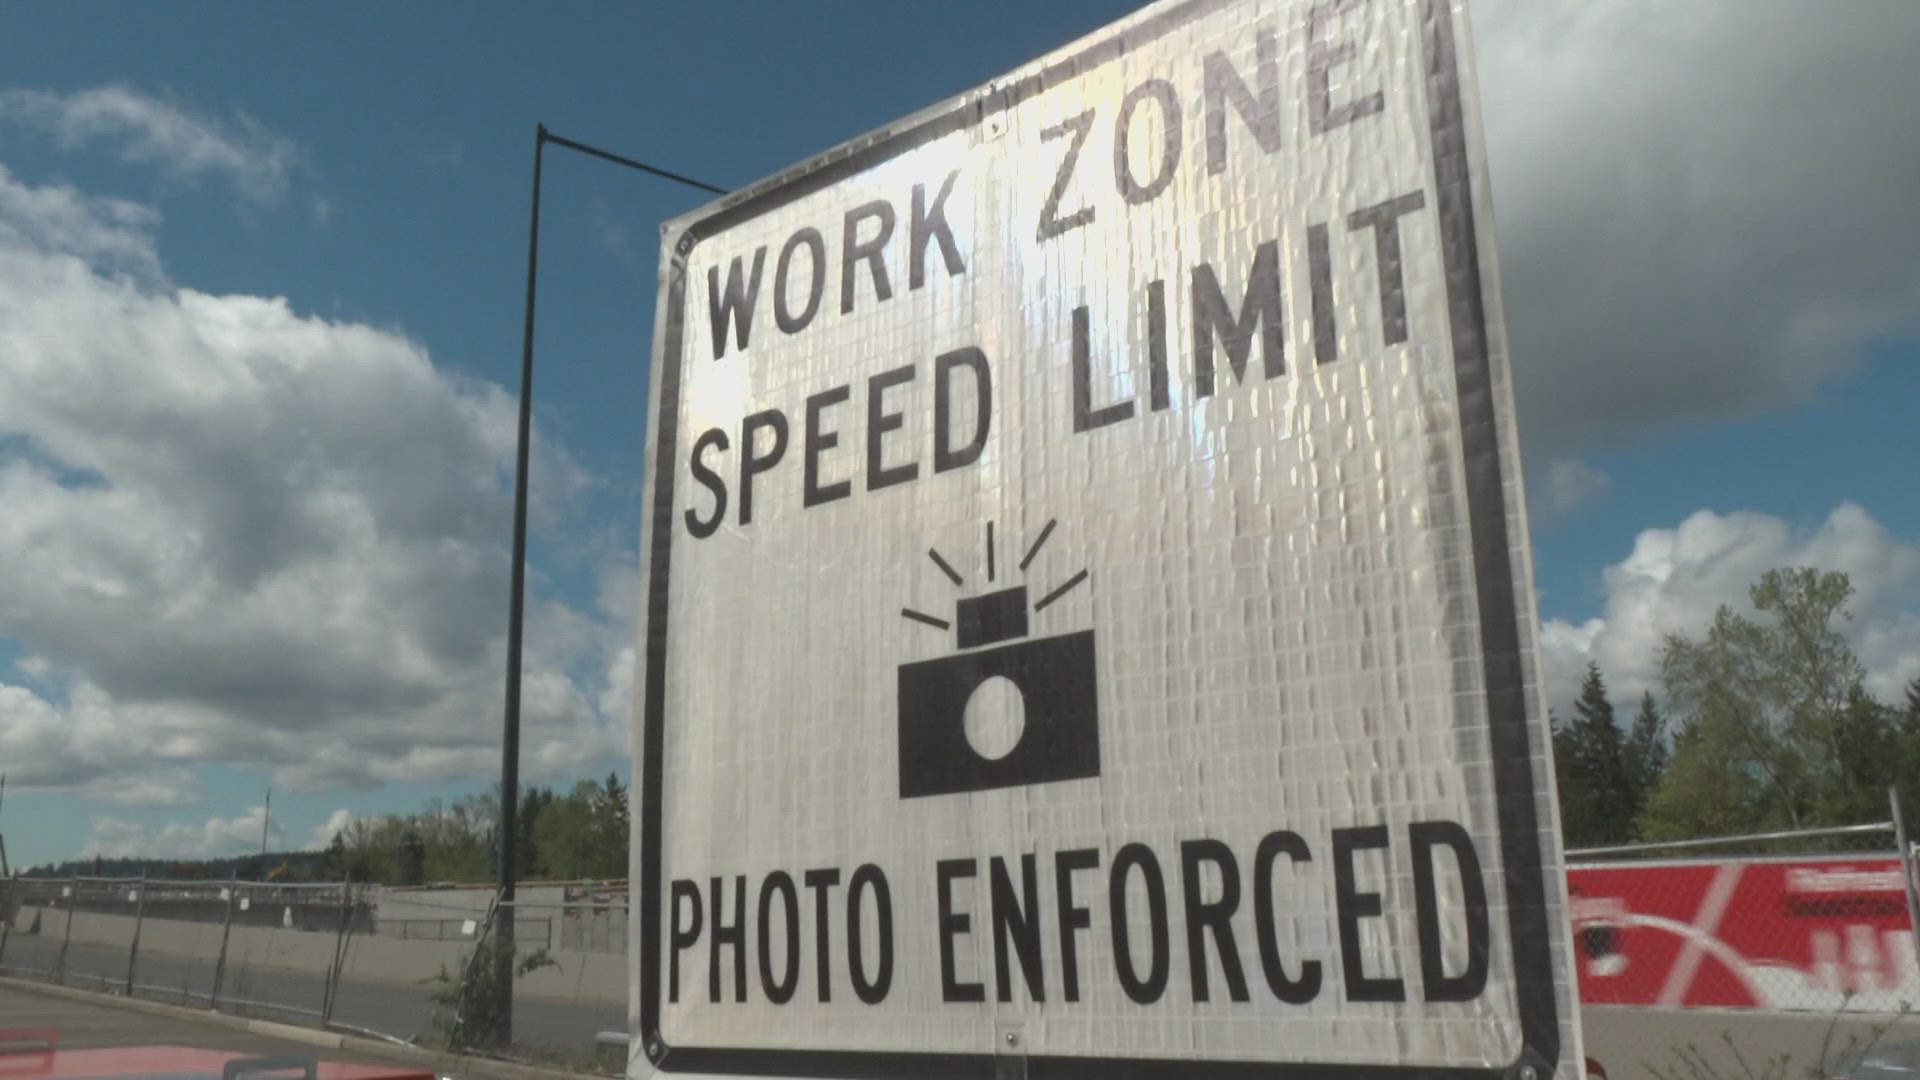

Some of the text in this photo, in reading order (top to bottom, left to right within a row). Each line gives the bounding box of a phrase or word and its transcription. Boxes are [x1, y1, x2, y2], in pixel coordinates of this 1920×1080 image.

[707, 0, 1386, 361] WORK ZONE
[684, 190, 1426, 539] SPEED LIMIT
[669, 821, 1490, 1005] PHOTO ENFORCED
